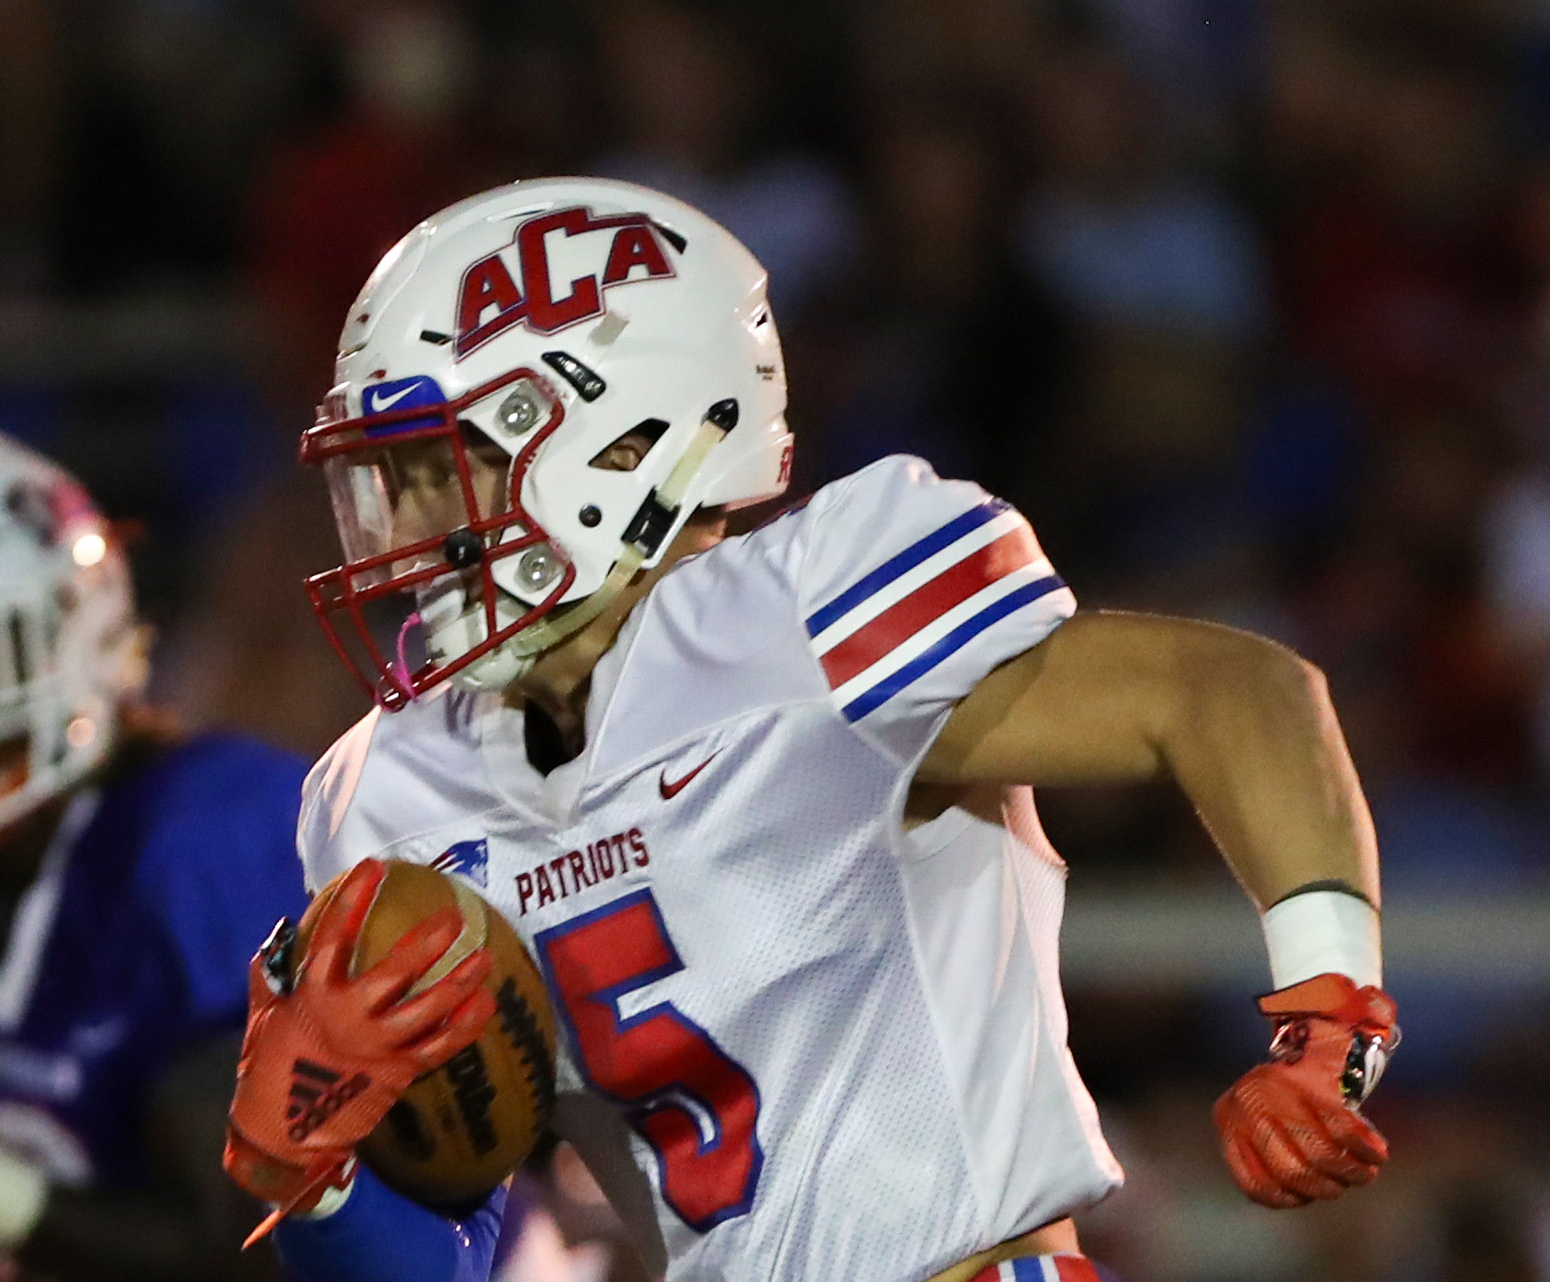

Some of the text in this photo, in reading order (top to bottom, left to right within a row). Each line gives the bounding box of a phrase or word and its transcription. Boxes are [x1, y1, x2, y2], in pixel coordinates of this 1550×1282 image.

[455, 206, 678, 363] ACA
[515, 828, 650, 917] PATRIOTS
[534, 887, 765, 1235] 5
